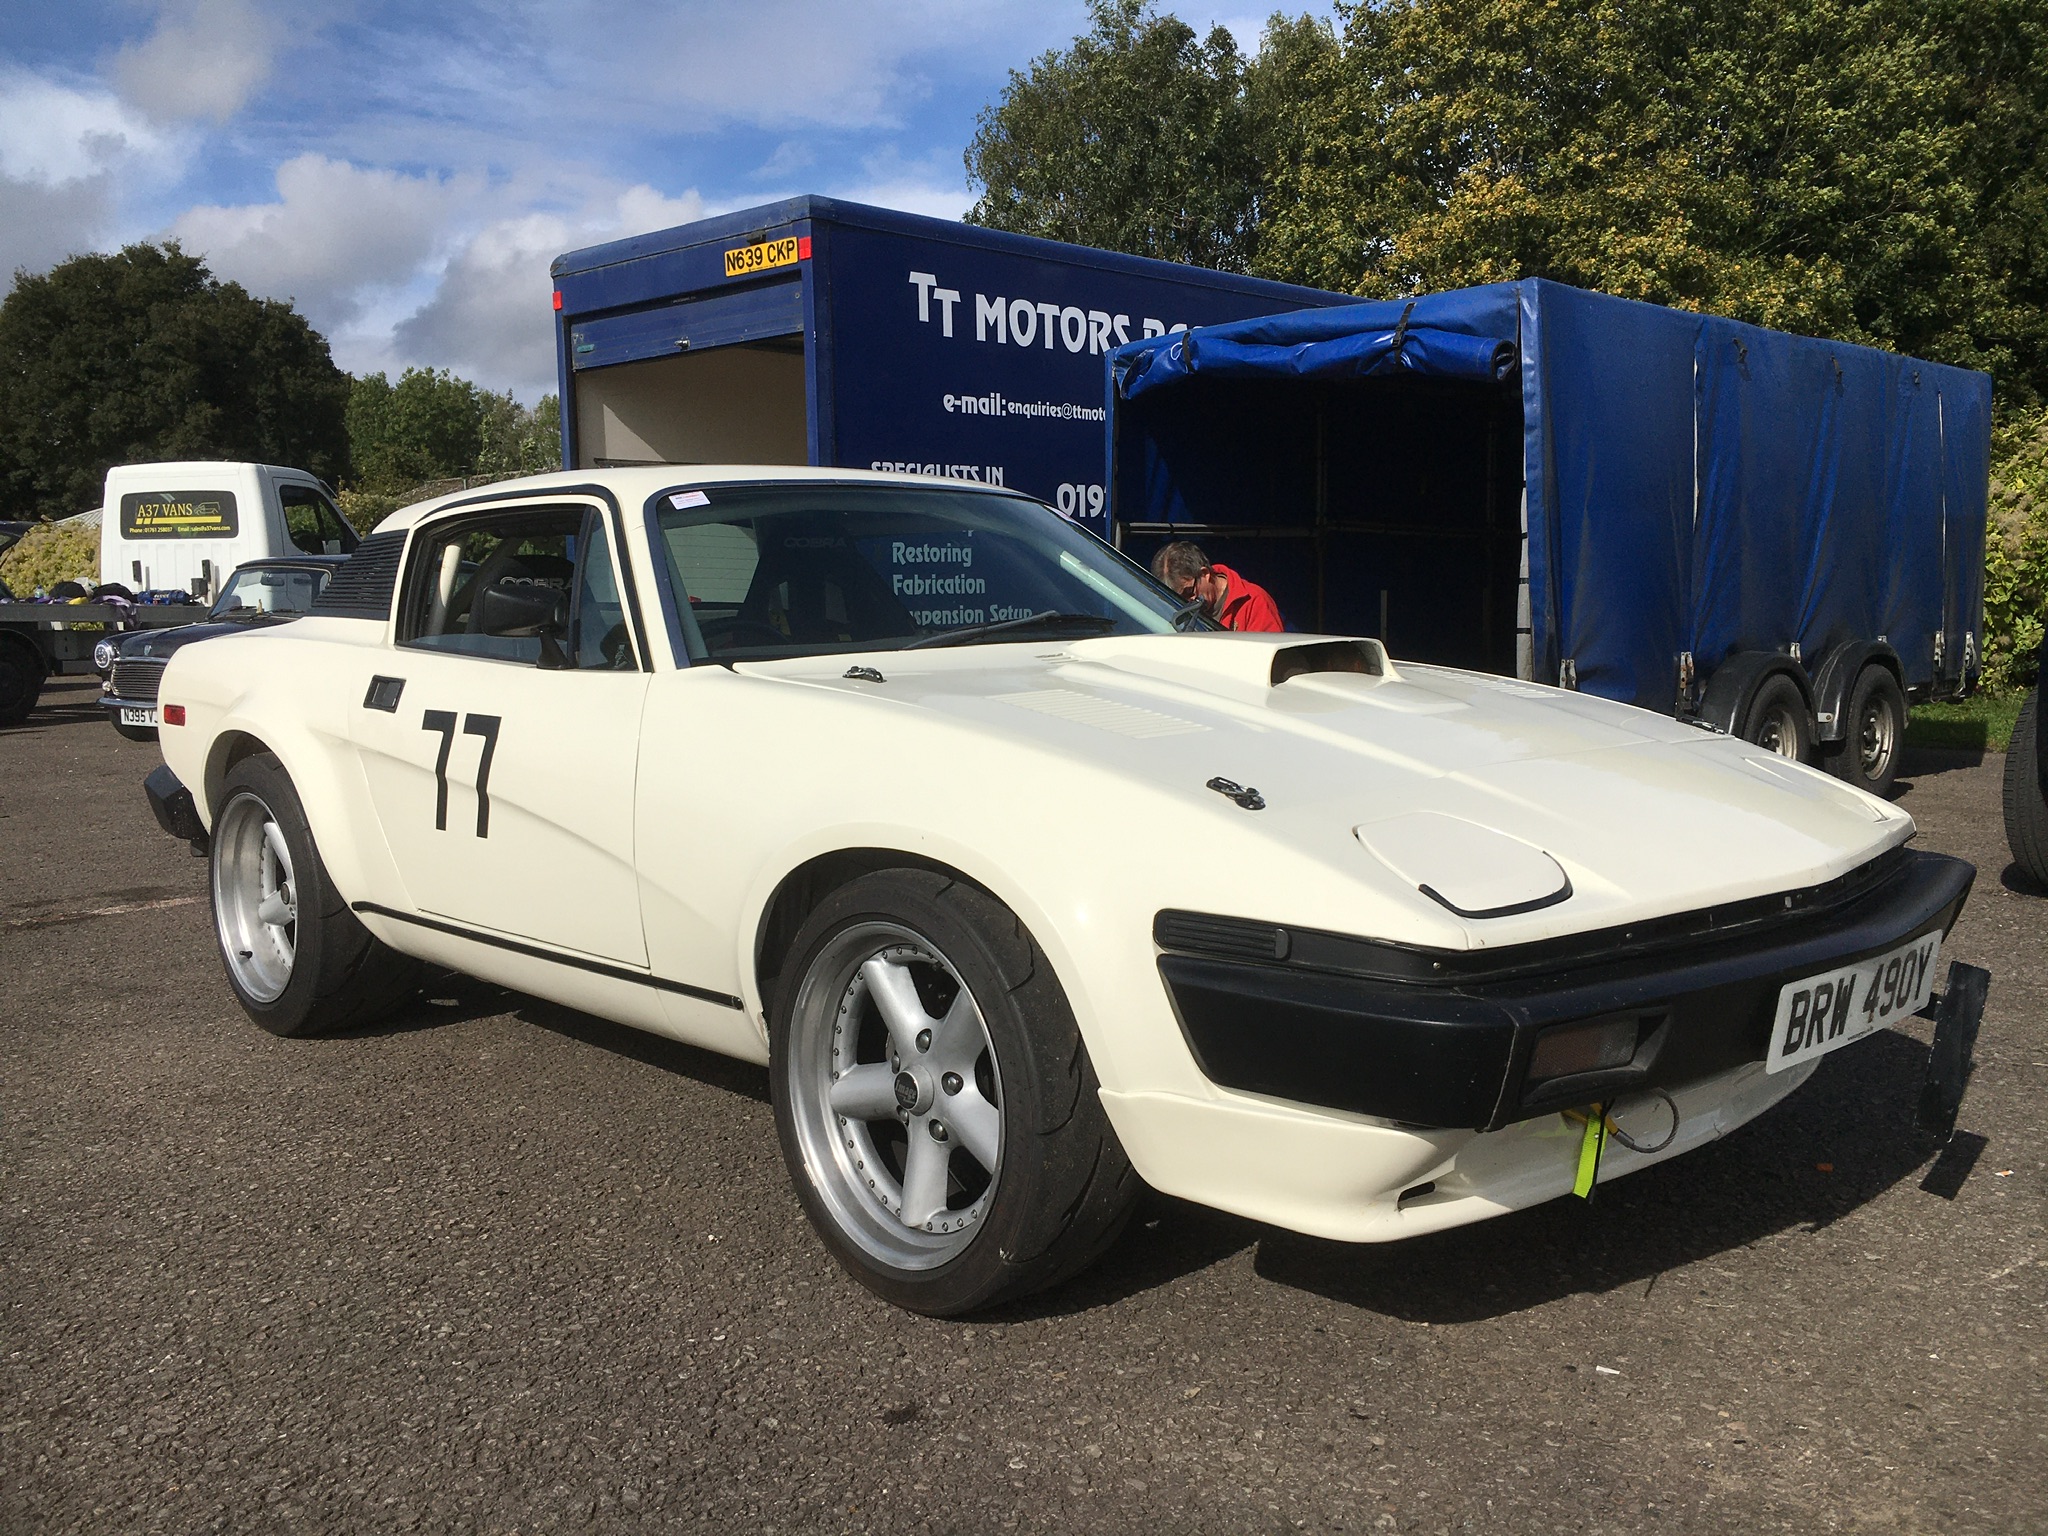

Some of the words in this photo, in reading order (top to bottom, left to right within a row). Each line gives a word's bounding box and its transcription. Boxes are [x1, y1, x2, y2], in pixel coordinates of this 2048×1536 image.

[726, 246, 763, 272] N639
[767, 239, 795, 263] CKP
[975, 293, 1131, 356] MOTORS
[943, 393, 1006, 416] e-mail:
[985, 466, 1004, 487] IN
[137, 504, 159, 517] A37
[163, 503, 193, 516] VANS
[1056, 482, 1106, 517] 019
[892, 542, 972, 567] Restoring
[893, 573, 986, 596] Fabrication
[909, 605, 984, 626] spension
[124, 709, 146, 723] N395
[421, 709, 502, 839] 77
[1781, 973, 1857, 1057] BRW
[1862, 942, 1934, 1024] 490Y
